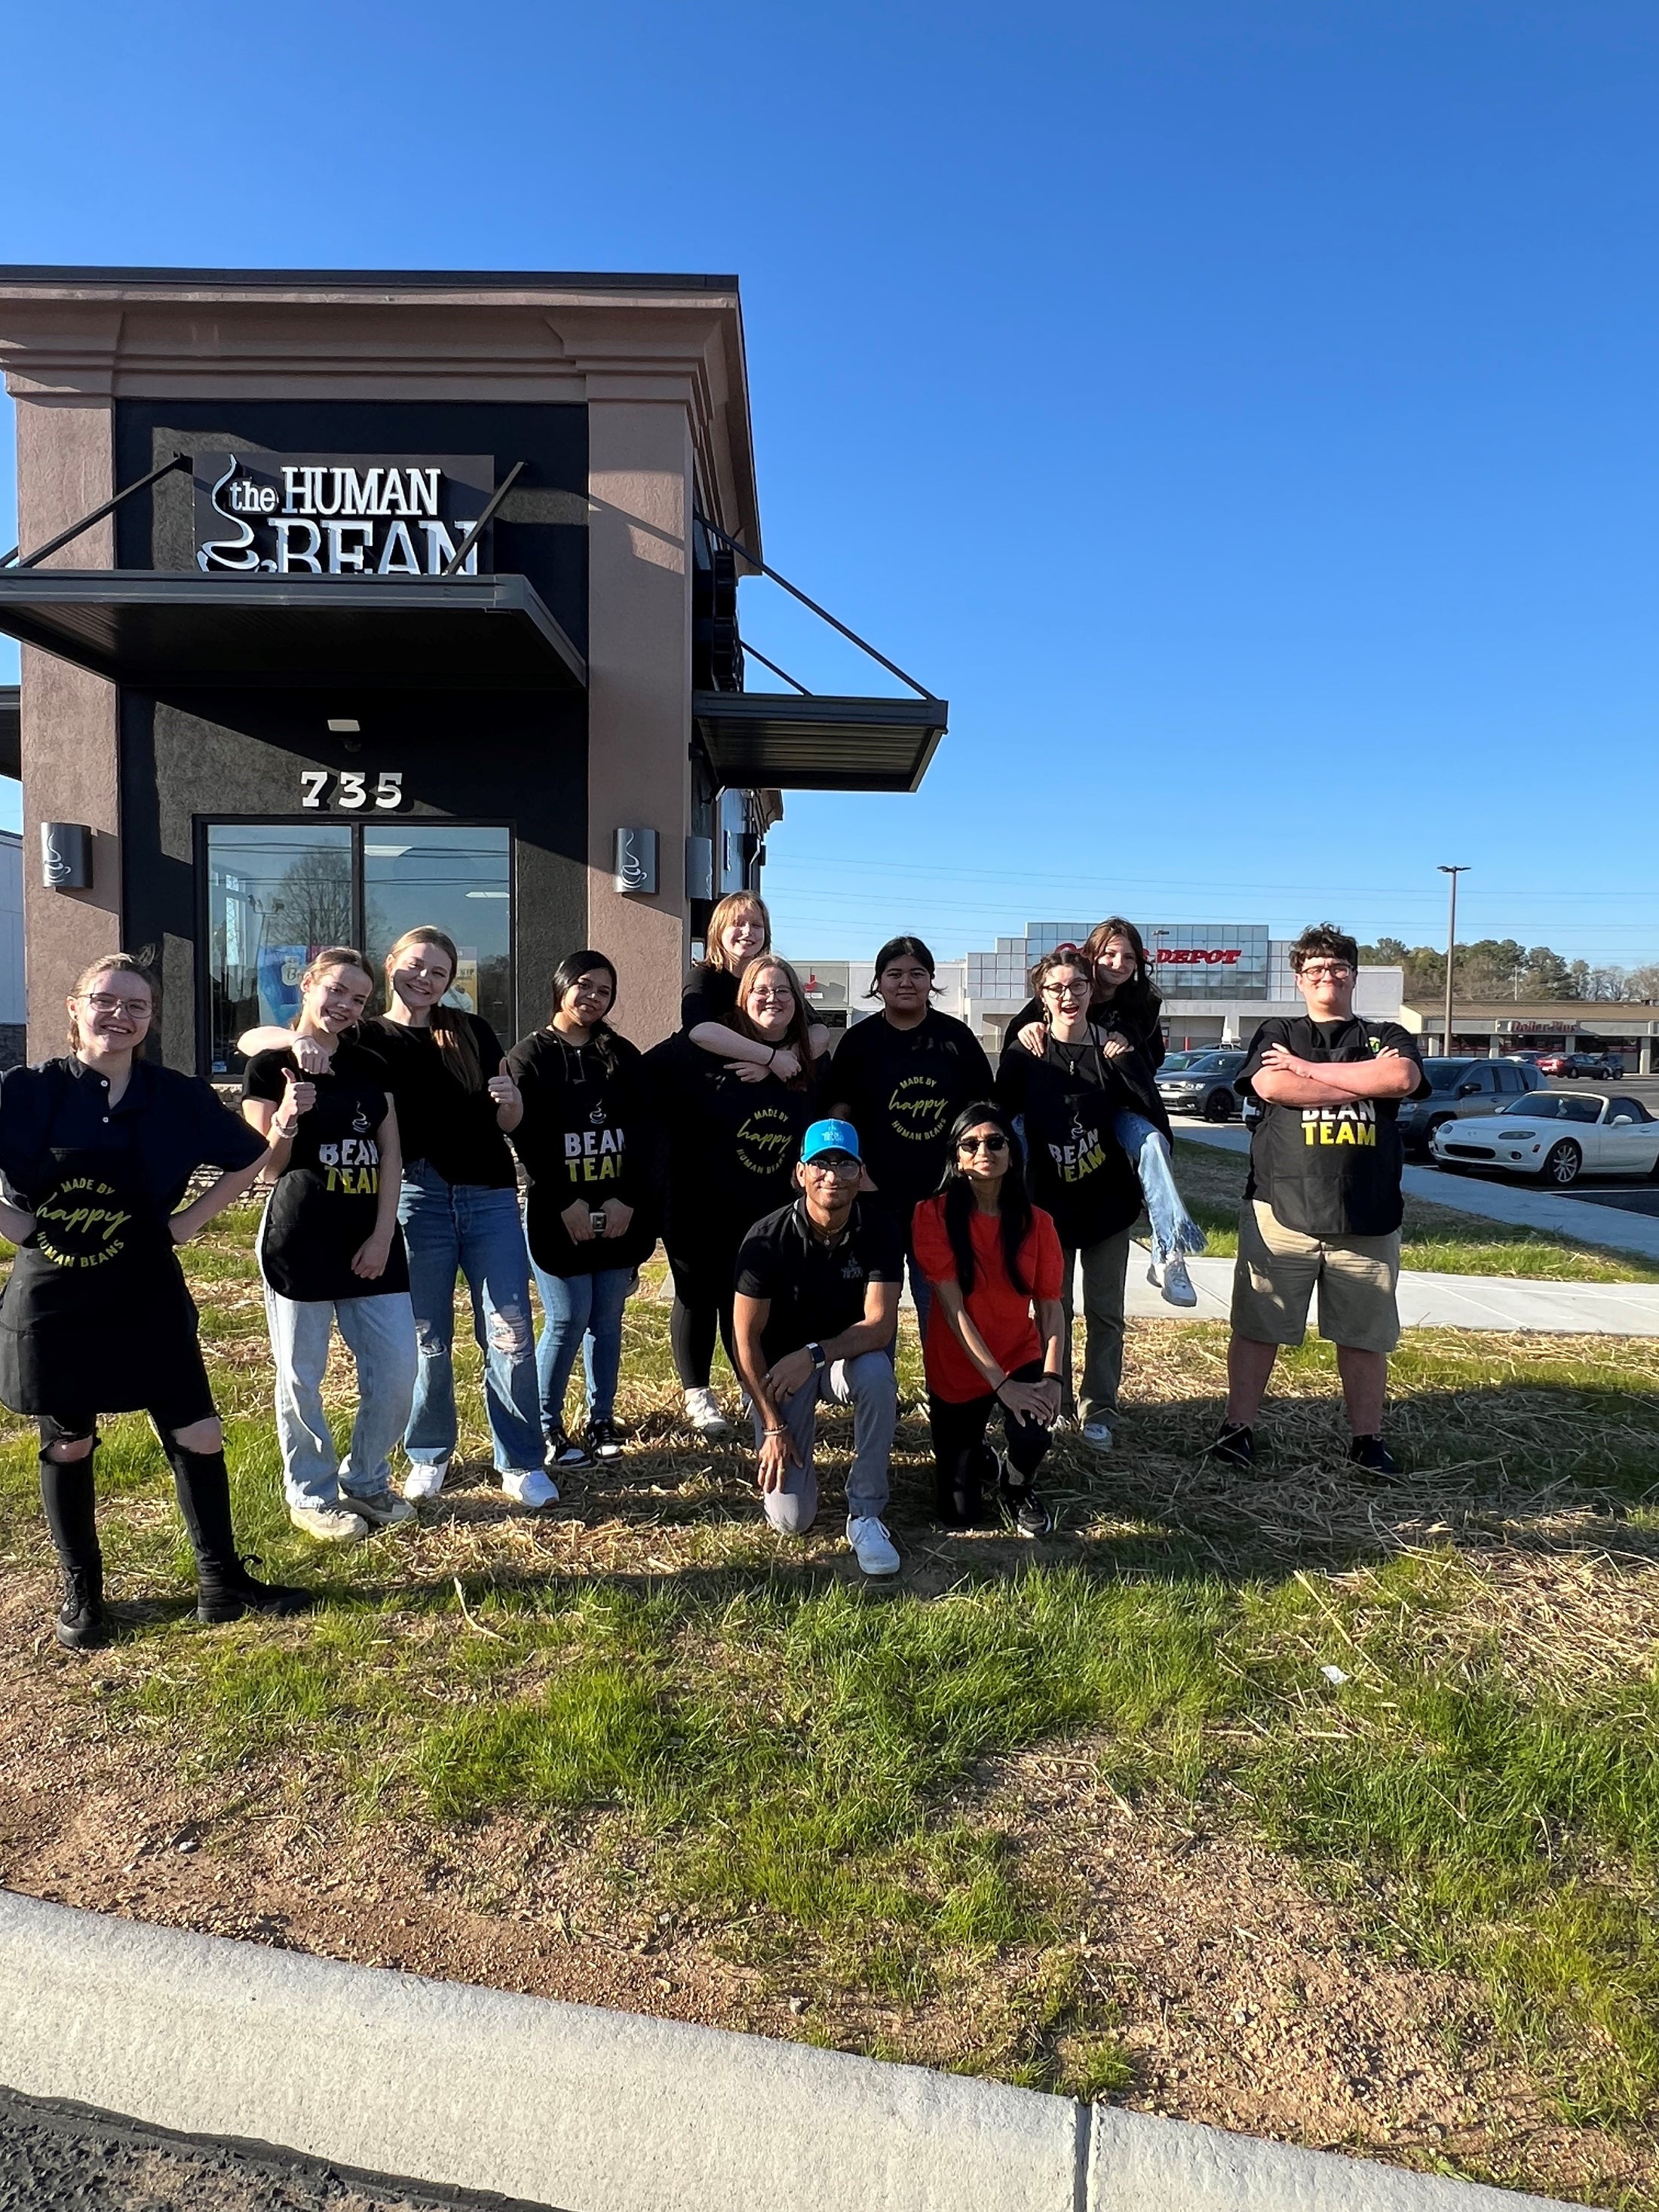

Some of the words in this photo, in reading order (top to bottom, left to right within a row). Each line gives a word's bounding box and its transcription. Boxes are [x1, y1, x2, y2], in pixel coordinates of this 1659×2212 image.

[229, 480, 278, 513] the
[281, 466, 441, 516] HUMAN
[267, 517, 478, 576] BEAN
[300, 771, 403, 809] 735
[1156, 948, 1242, 965] DEPOT
[900, 1076, 925, 1089] MADE
[925, 1077, 937, 1088] BY
[754, 1108, 778, 1120] MADE
[778, 1111, 789, 1122] BY
[888, 1088, 949, 1120] happy
[736, 1118, 793, 1154] happy
[891, 1120, 921, 1140] HUMAN
[1048, 1128, 1099, 1164] BEAN
[1301, 1121, 1376, 1146] TEAM
[736, 1149, 764, 1173] HUMAN
[60, 1177, 95, 1193] MADE
[96, 1183, 115, 1195] BY
[35, 1192, 132, 1240] happy
[37, 1231, 75, 1268] HUMAN
[80, 1239, 124, 1268] BEANS
